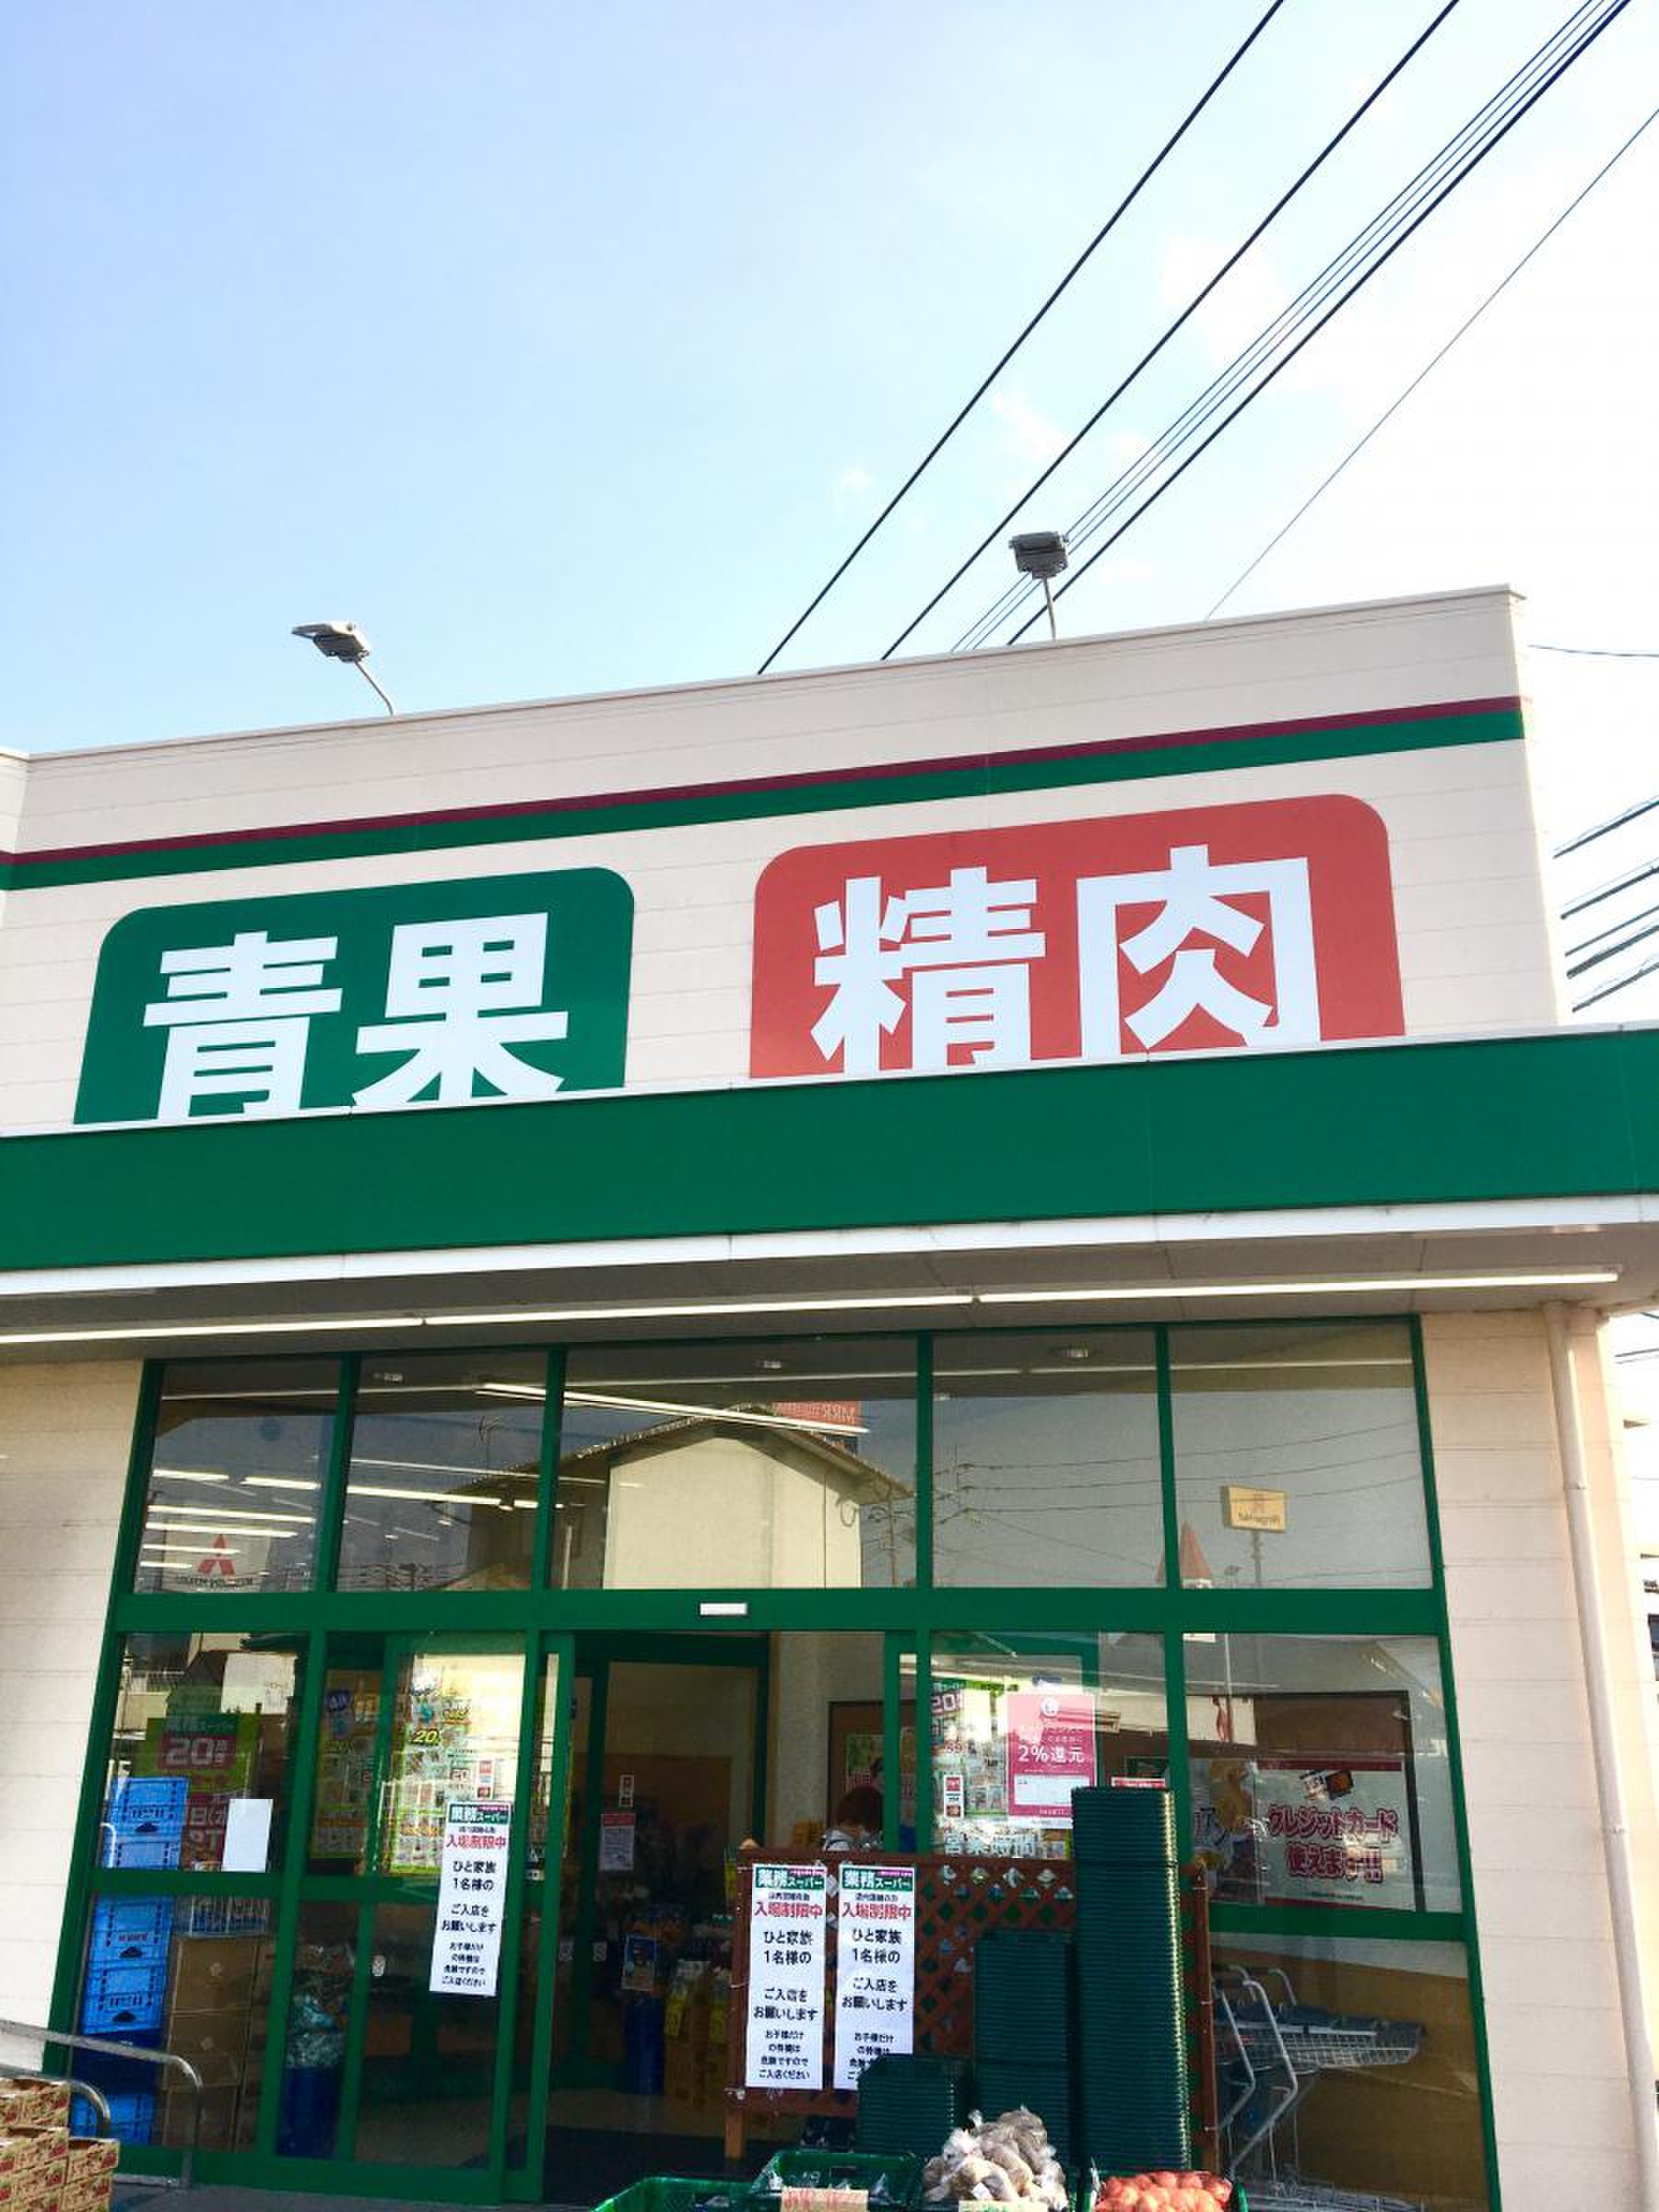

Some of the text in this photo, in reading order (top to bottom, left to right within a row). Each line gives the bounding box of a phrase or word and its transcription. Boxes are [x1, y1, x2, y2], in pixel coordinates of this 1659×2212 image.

[810, 843, 1321, 1077] 精肉
[143, 912, 568, 1120] 青果
[1018, 1745, 1085, 1763] 2%還元
[1267, 1804, 1398, 1841] クレジットカード
[446, 1834, 506, 1849] 入場制限中
[453, 1860, 496, 1873] ひと家族
[453, 1877, 494, 1891] 1名様の
[756, 1868, 824, 1888] 業務スーパー
[843, 1869, 912, 1889] 業務スーパー
[451, 1903, 488, 1917] ご入店を
[754, 1902, 823, 1919] 入場制限中
[841, 1903, 912, 1921] 入場制限中
[442, 1920, 496, 1933] お願いします
[763, 1931, 812, 1946] ひと家族
[852, 1928, 902, 1945] ひと家族
[764, 1950, 812, 1965] 1名様の
[853, 1947, 900, 1963] 1名様の
[853, 1977, 898, 1993] ご入店を
[764, 1988, 808, 2003] ご入店を
[841, 1995, 908, 2012] お願いします
[753, 2006, 818, 2020] お願いします
